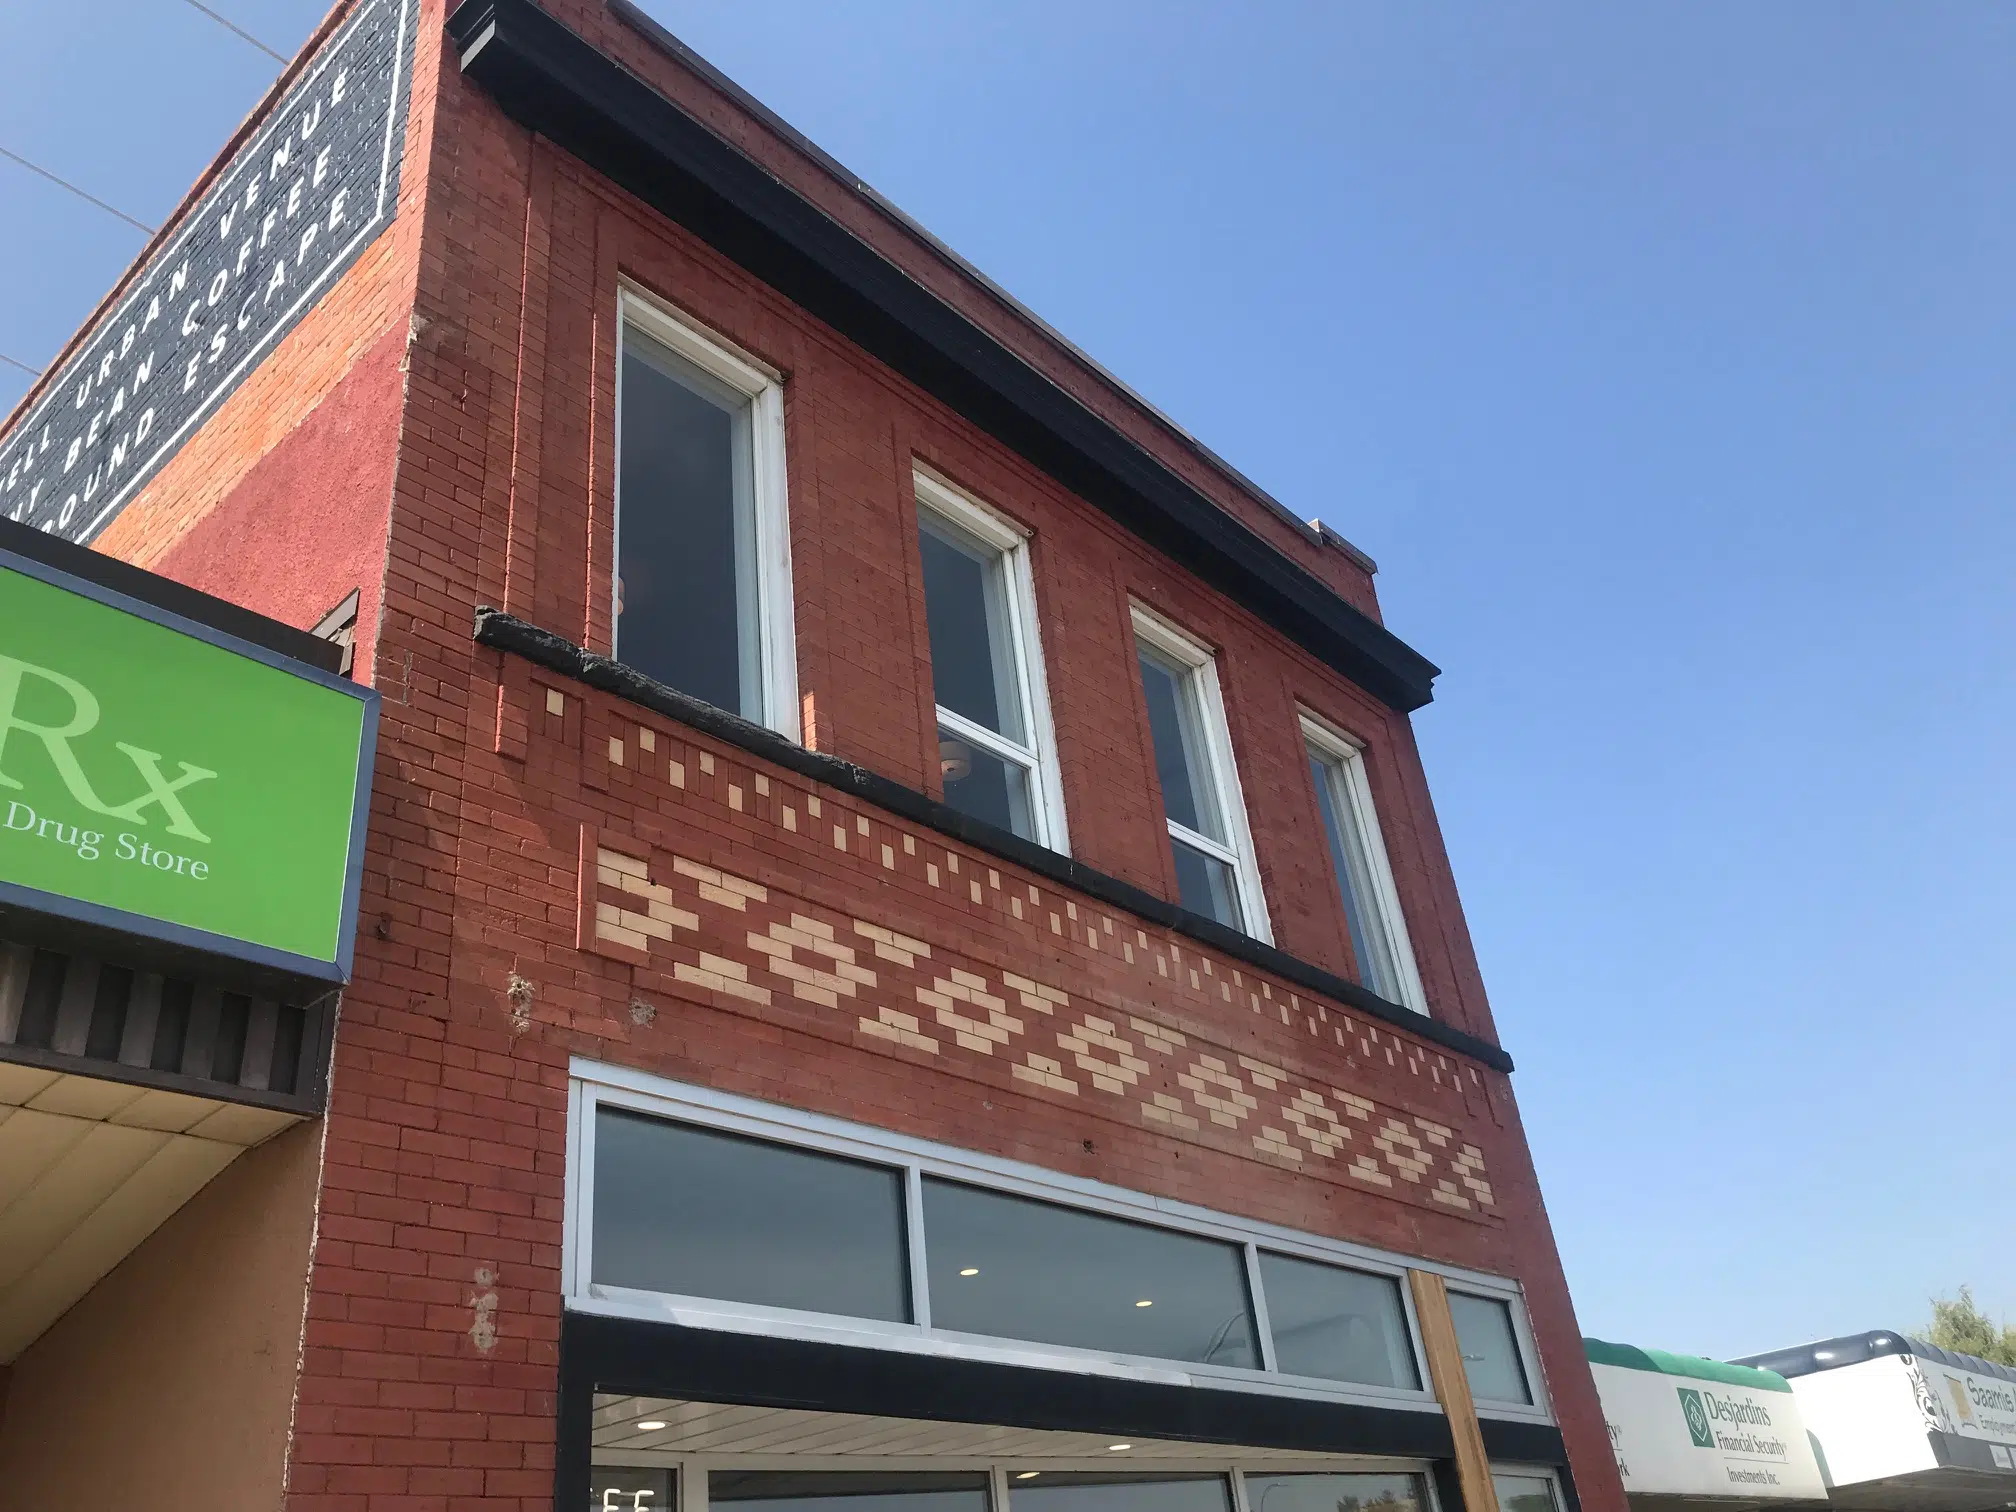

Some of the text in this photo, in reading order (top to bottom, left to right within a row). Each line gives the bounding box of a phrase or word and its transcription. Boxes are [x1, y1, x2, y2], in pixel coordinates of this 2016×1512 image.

[0, 68, 350, 493] ELL URBAN VENUE
[64, 351, 156, 474] BEAN
[181, 144, 331, 337] COFFEE
[182, 187, 349, 395] ESCAPE
[0, 654, 218, 844] Rx
[2, 800, 209, 881] Drug Store
[1703, 1391, 1771, 1431] Desjardins
[1966, 1376, 2014, 1413] Saamis
[1715, 1430, 1755, 1453] Financial
[1726, 1466, 1767, 1485] Investments
